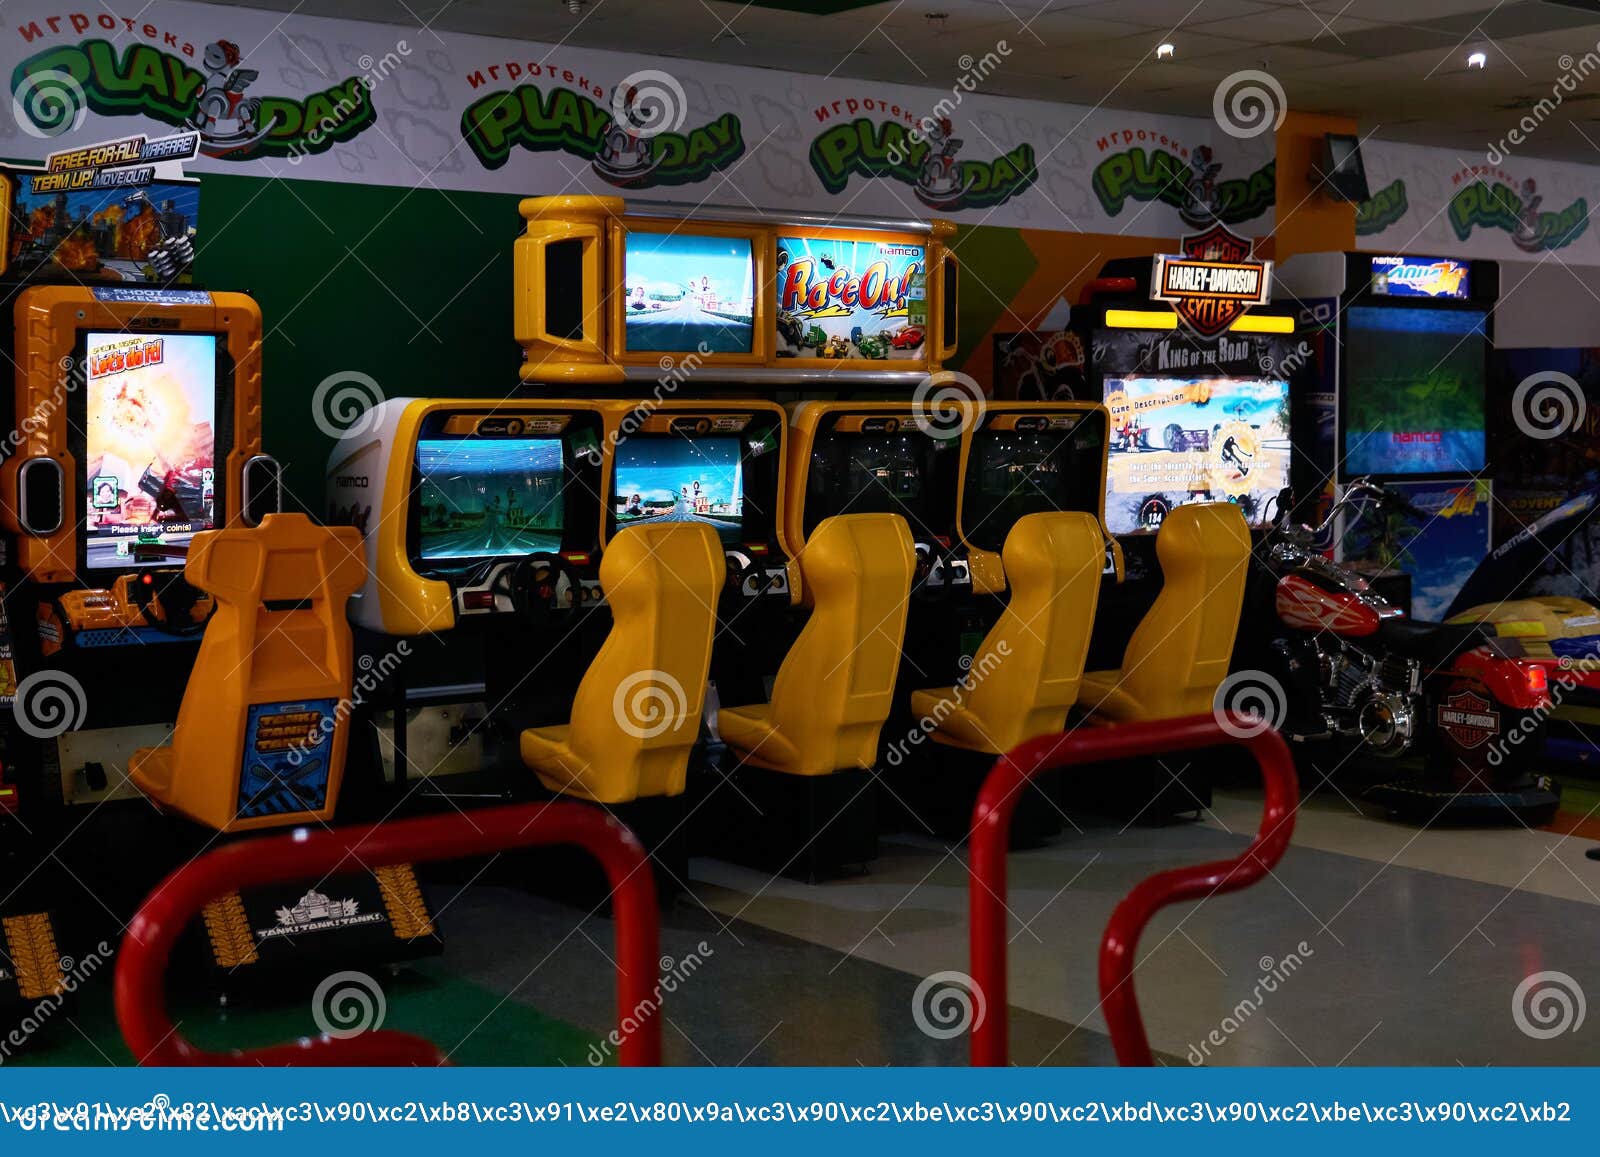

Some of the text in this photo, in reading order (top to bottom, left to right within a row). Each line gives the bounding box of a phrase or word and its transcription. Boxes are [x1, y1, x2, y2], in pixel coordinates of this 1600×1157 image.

[11, 38, 377, 160] PLAY DAY
[461, 84, 745, 186] PLAY DAY
[51, 136, 194, 172] FREE-FOR-ALL WARFARE!
[809, 117, 1039, 209] PLAY DAY
[33, 168, 150, 190] TEAM UP! MOVE OUT!
[1092, 147, 1193, 217] PLAY
[880, 247, 919, 257] namco
[1168, 266, 1259, 294] HARLEY-DAVIDSON
[1187, 298, 1235, 320] CYCLES
[1111, 404, 1130, 414] Game
[1392, 431, 1441, 443] namco
[111, 525, 138, 534] Please
[1148, 512, 1162, 524] 134
[257, 913, 380, 937] TANK! TANK! TANK!
